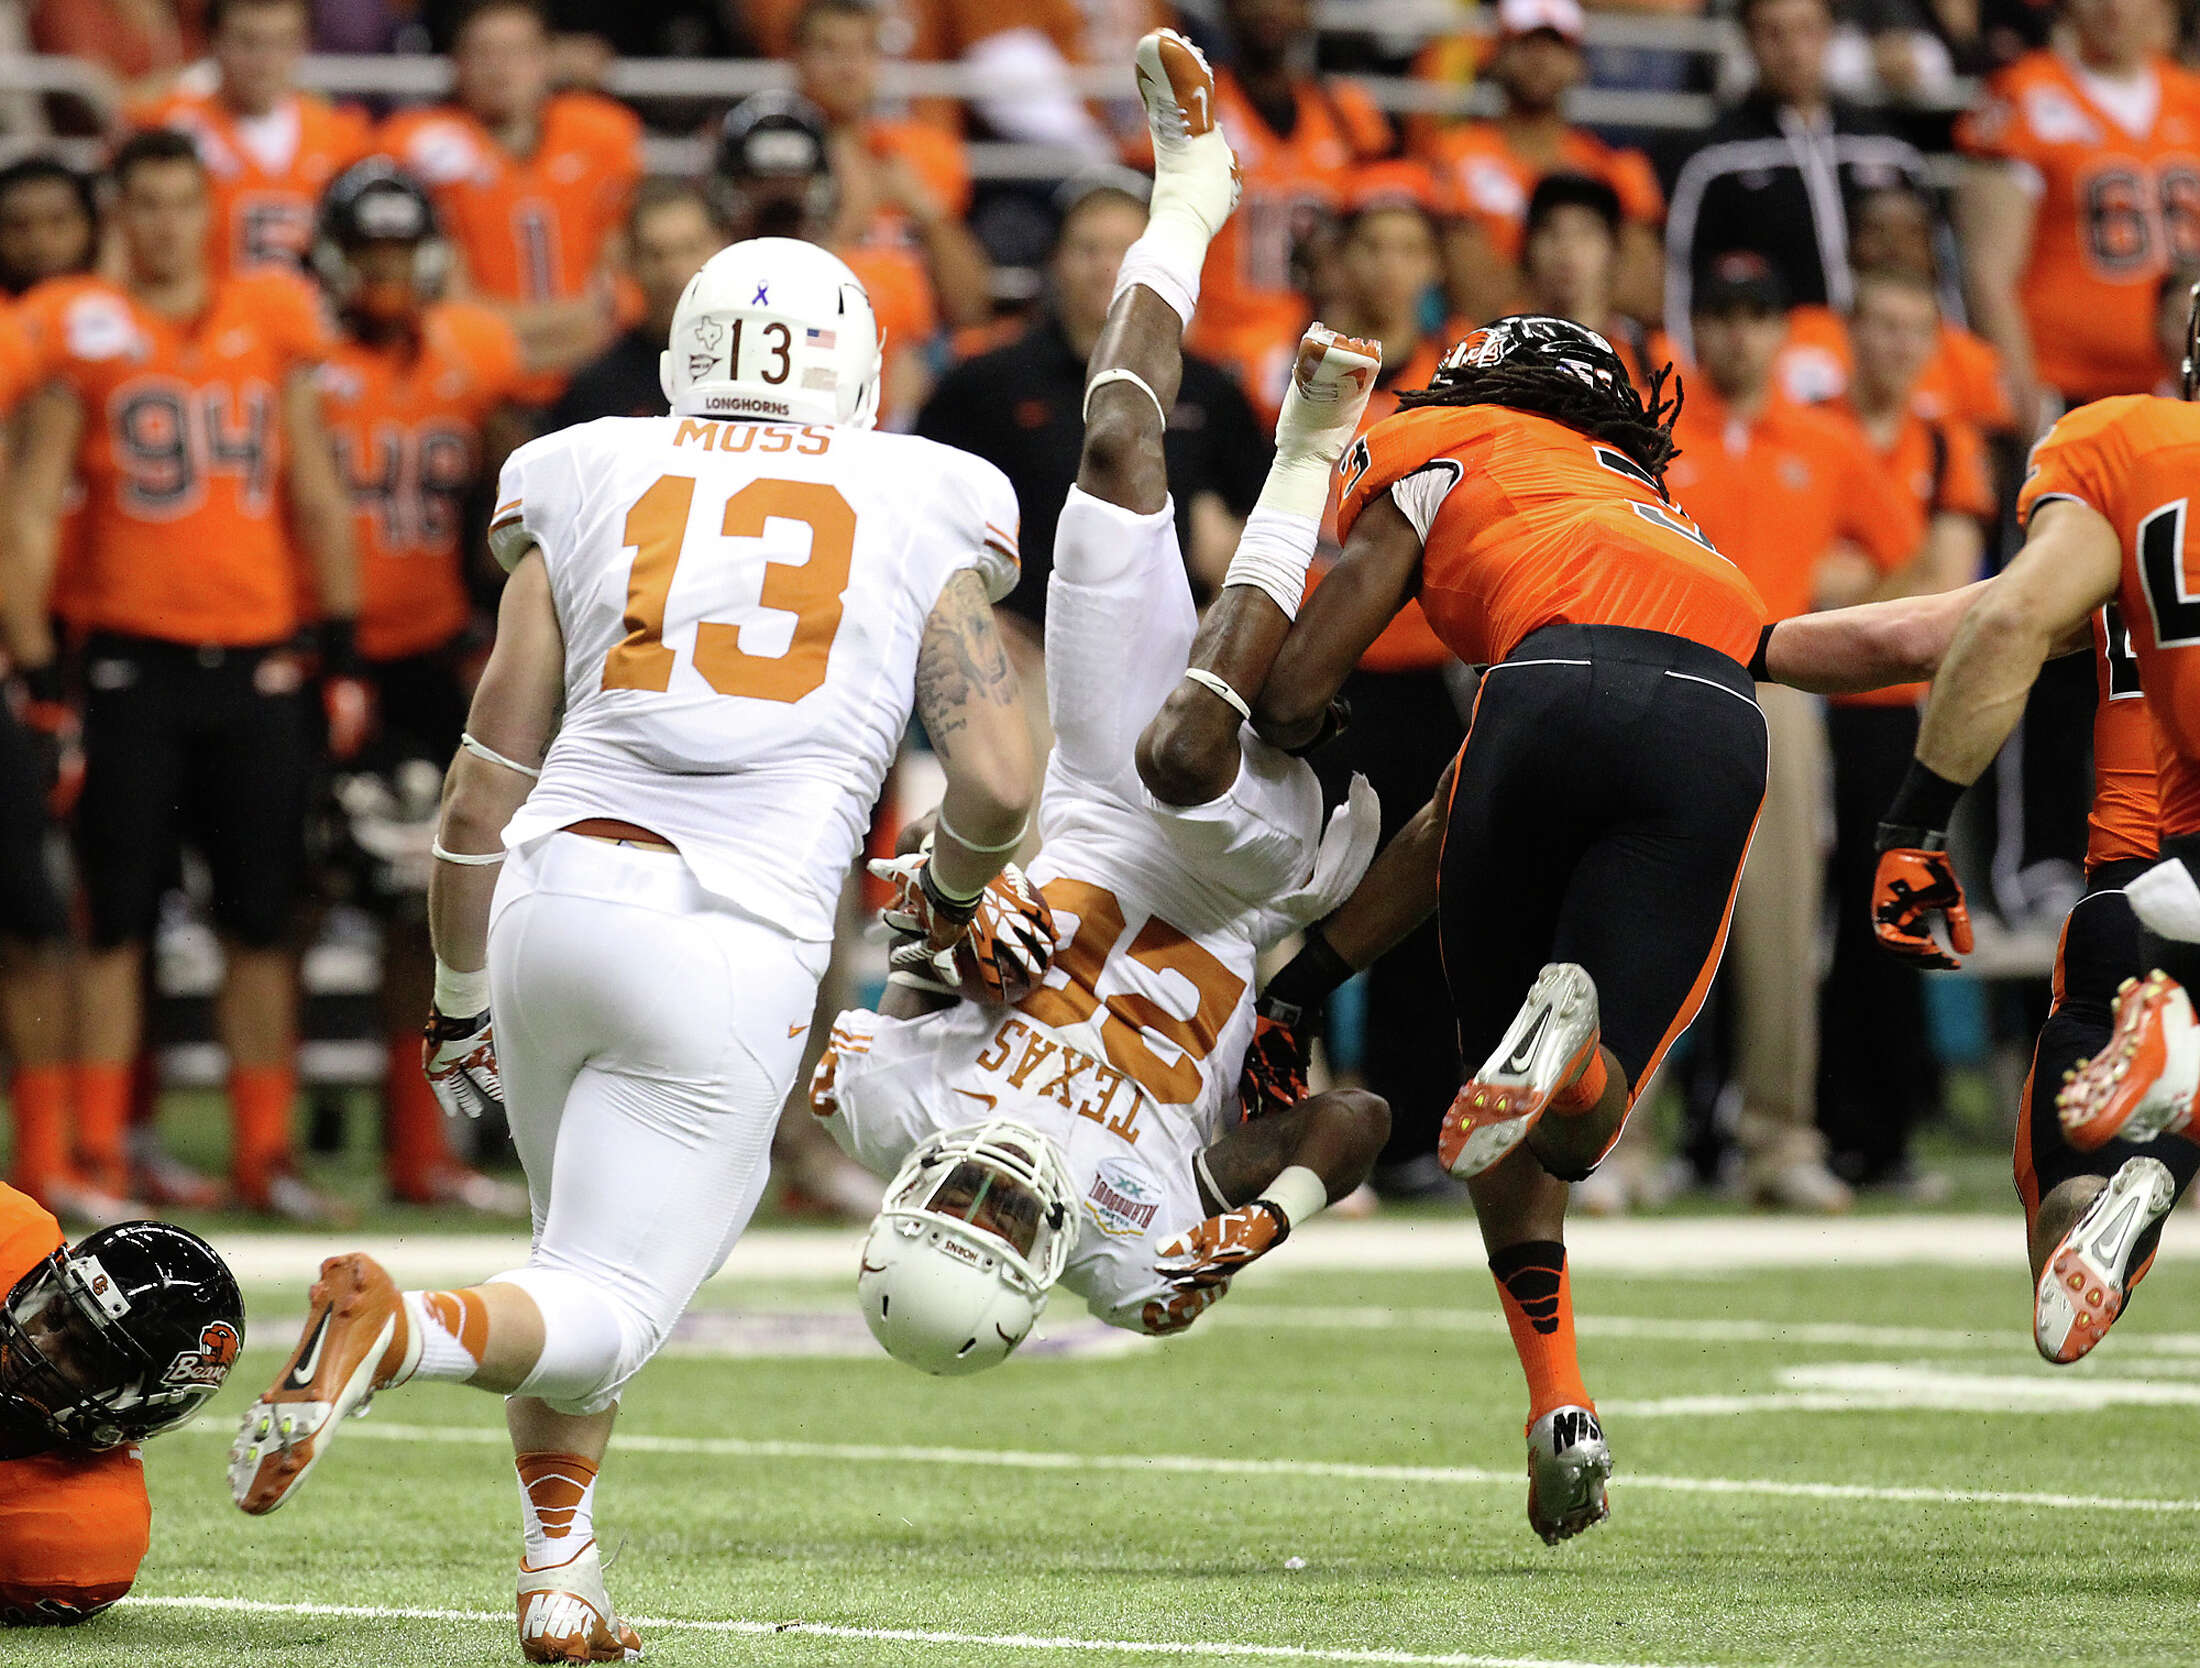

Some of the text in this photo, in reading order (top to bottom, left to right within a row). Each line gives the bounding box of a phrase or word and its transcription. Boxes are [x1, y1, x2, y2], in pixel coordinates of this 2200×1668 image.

[730, 318, 791, 385] 13
[673, 418, 835, 455] MOSS
[705, 397, 790, 416] LONGHORNS
[112, 382, 274, 520] 94
[600, 474, 857, 704] 13
[976, 1018, 1141, 1145] TEXAS
[944, 1240, 979, 1262] HORNS
